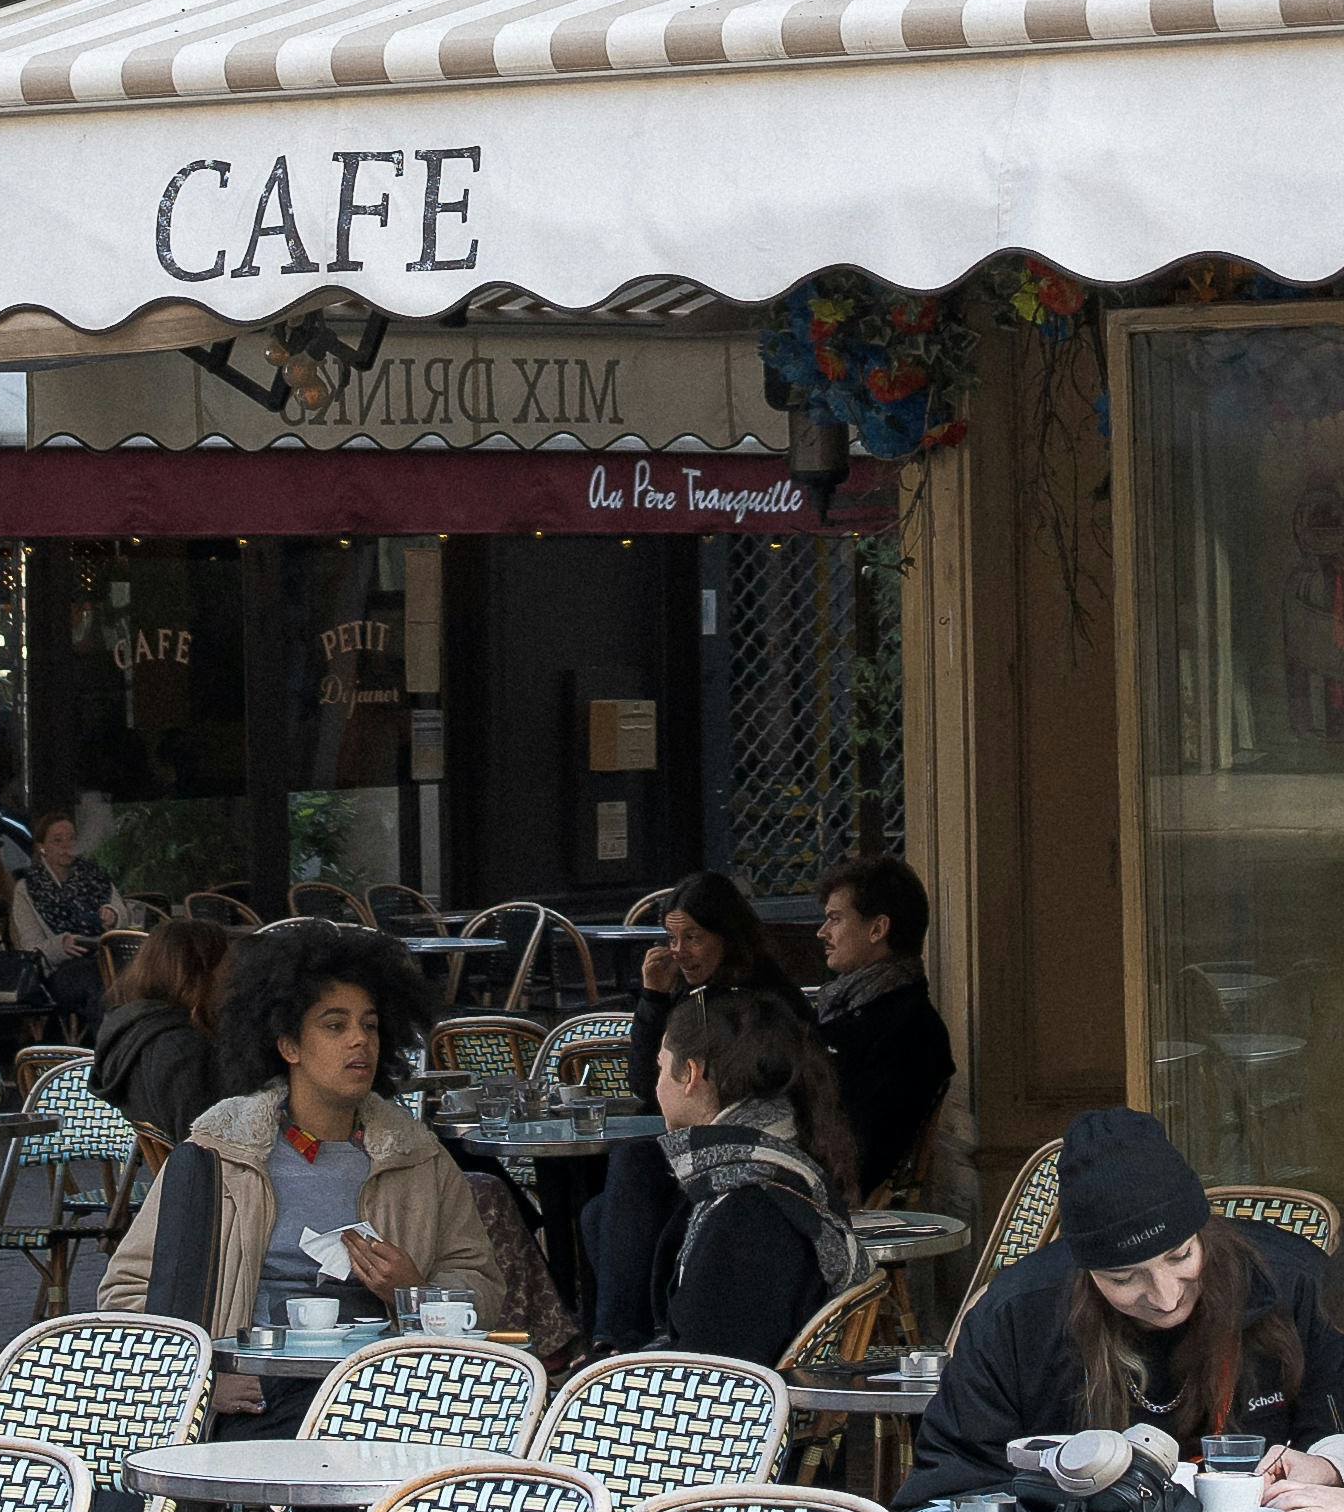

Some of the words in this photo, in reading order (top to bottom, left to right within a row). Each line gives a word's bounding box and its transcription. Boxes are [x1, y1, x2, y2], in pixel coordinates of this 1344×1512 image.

[154, 144, 483, 283] CAFE
[588, 464, 623, 509] Au
[632, 459, 678, 510] Père
[681, 467, 804, 524] Tranquille
[319, 619, 390, 661] PETIT
[1116, 1222, 1167, 1249] adidas
[1247, 1391, 1285, 1412] Schott
